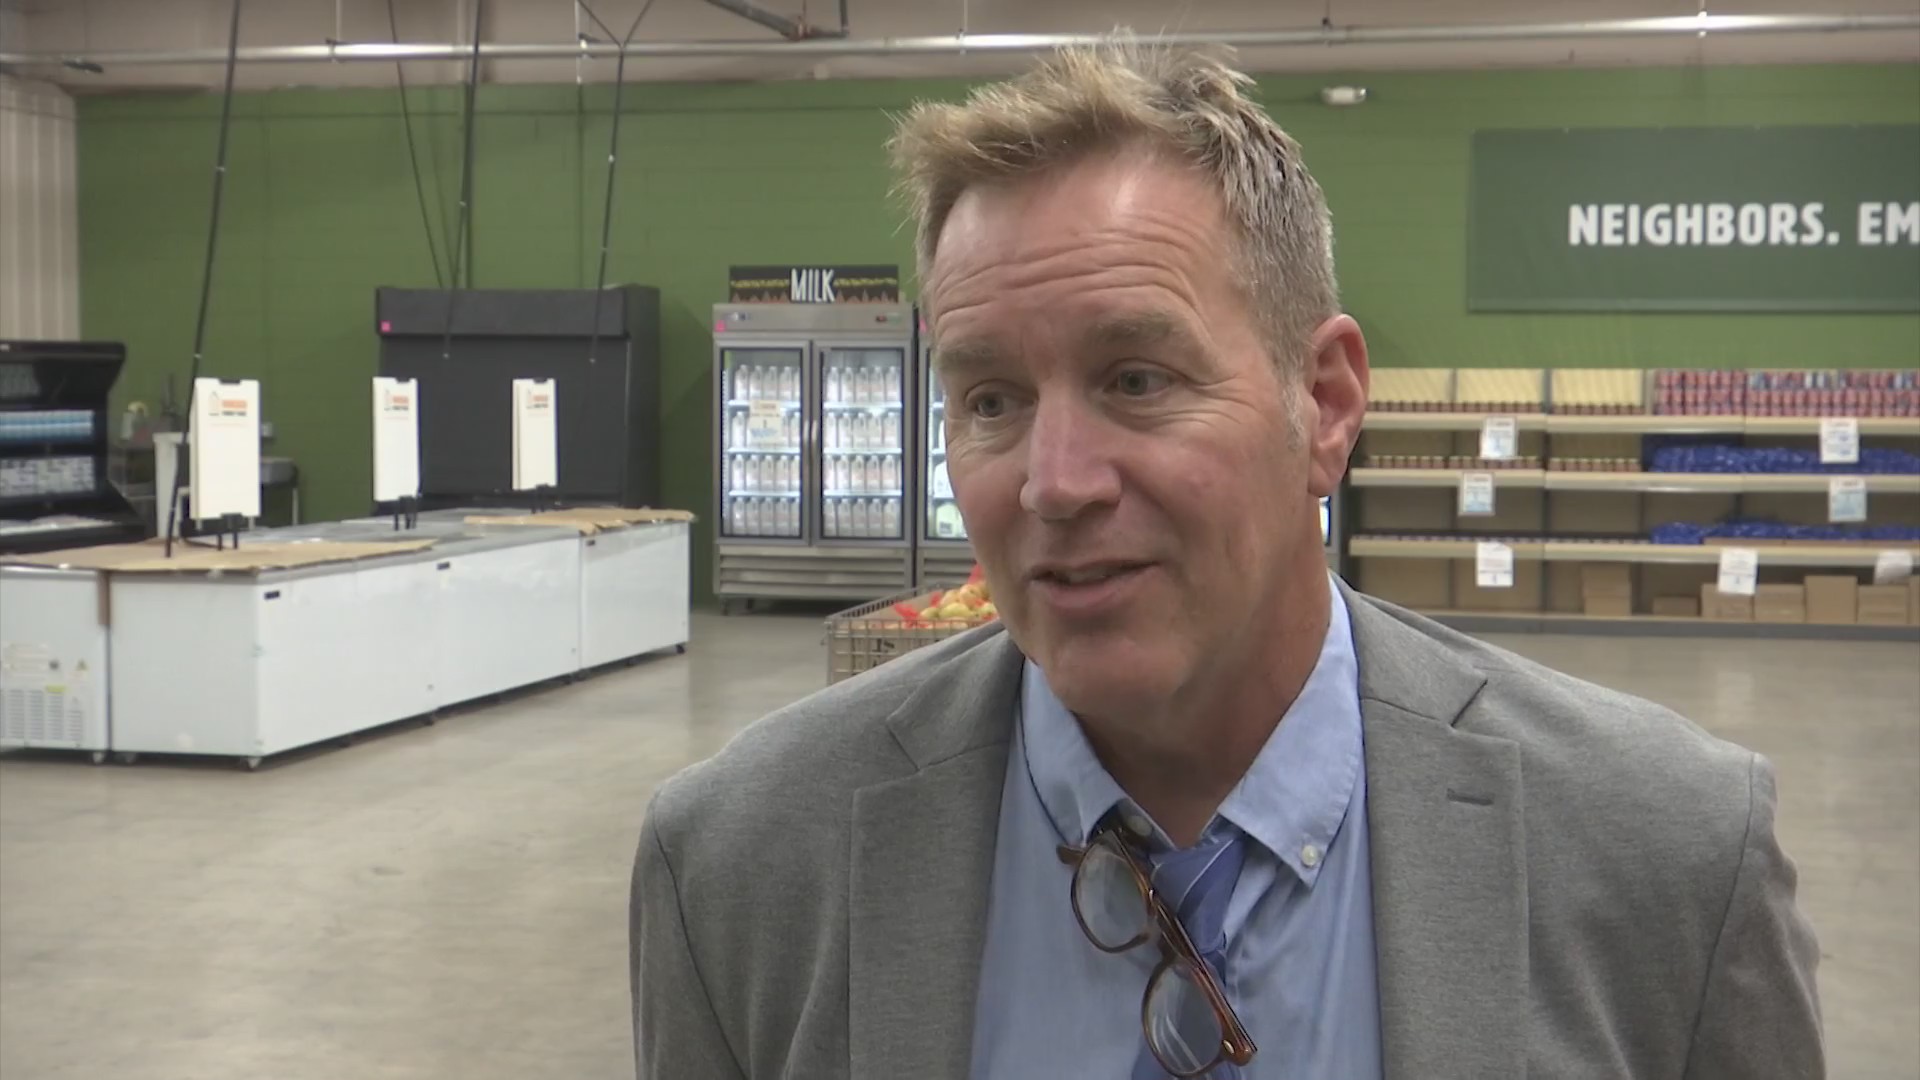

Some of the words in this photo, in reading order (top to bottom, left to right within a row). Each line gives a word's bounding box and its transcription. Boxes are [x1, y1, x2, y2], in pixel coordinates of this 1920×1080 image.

[1568, 203, 1840, 246] NEIGHBORS.
[1858, 202, 1920, 245] EM
[791, 268, 835, 302] MILK
